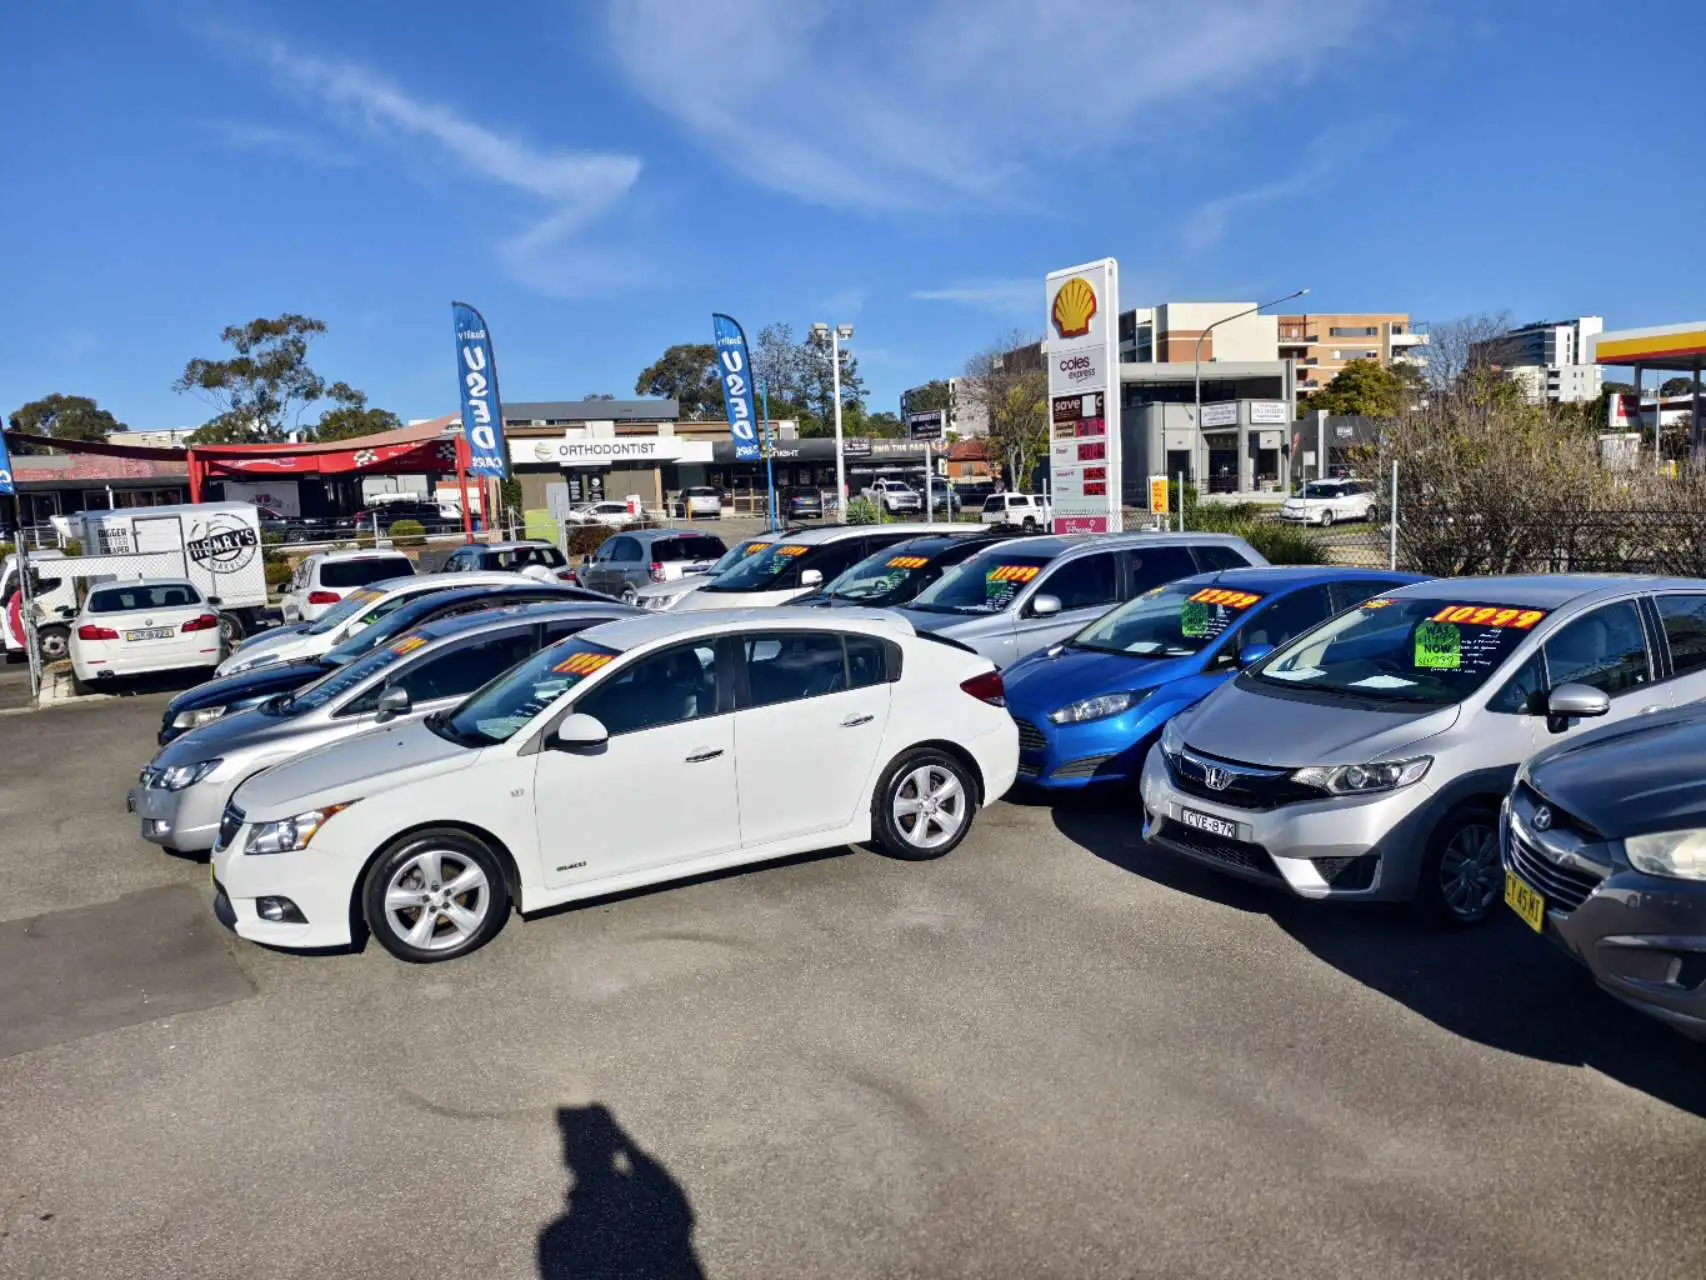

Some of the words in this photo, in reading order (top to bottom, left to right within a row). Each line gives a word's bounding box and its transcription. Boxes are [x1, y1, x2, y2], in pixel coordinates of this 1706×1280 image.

[1060, 356, 1090, 372] coles
[1054, 399, 1081, 411] save
[558, 442, 656, 456] ORTHODONTIST
[1432, 605, 1544, 629] 10999
[1424, 644, 1452, 654] NOW
